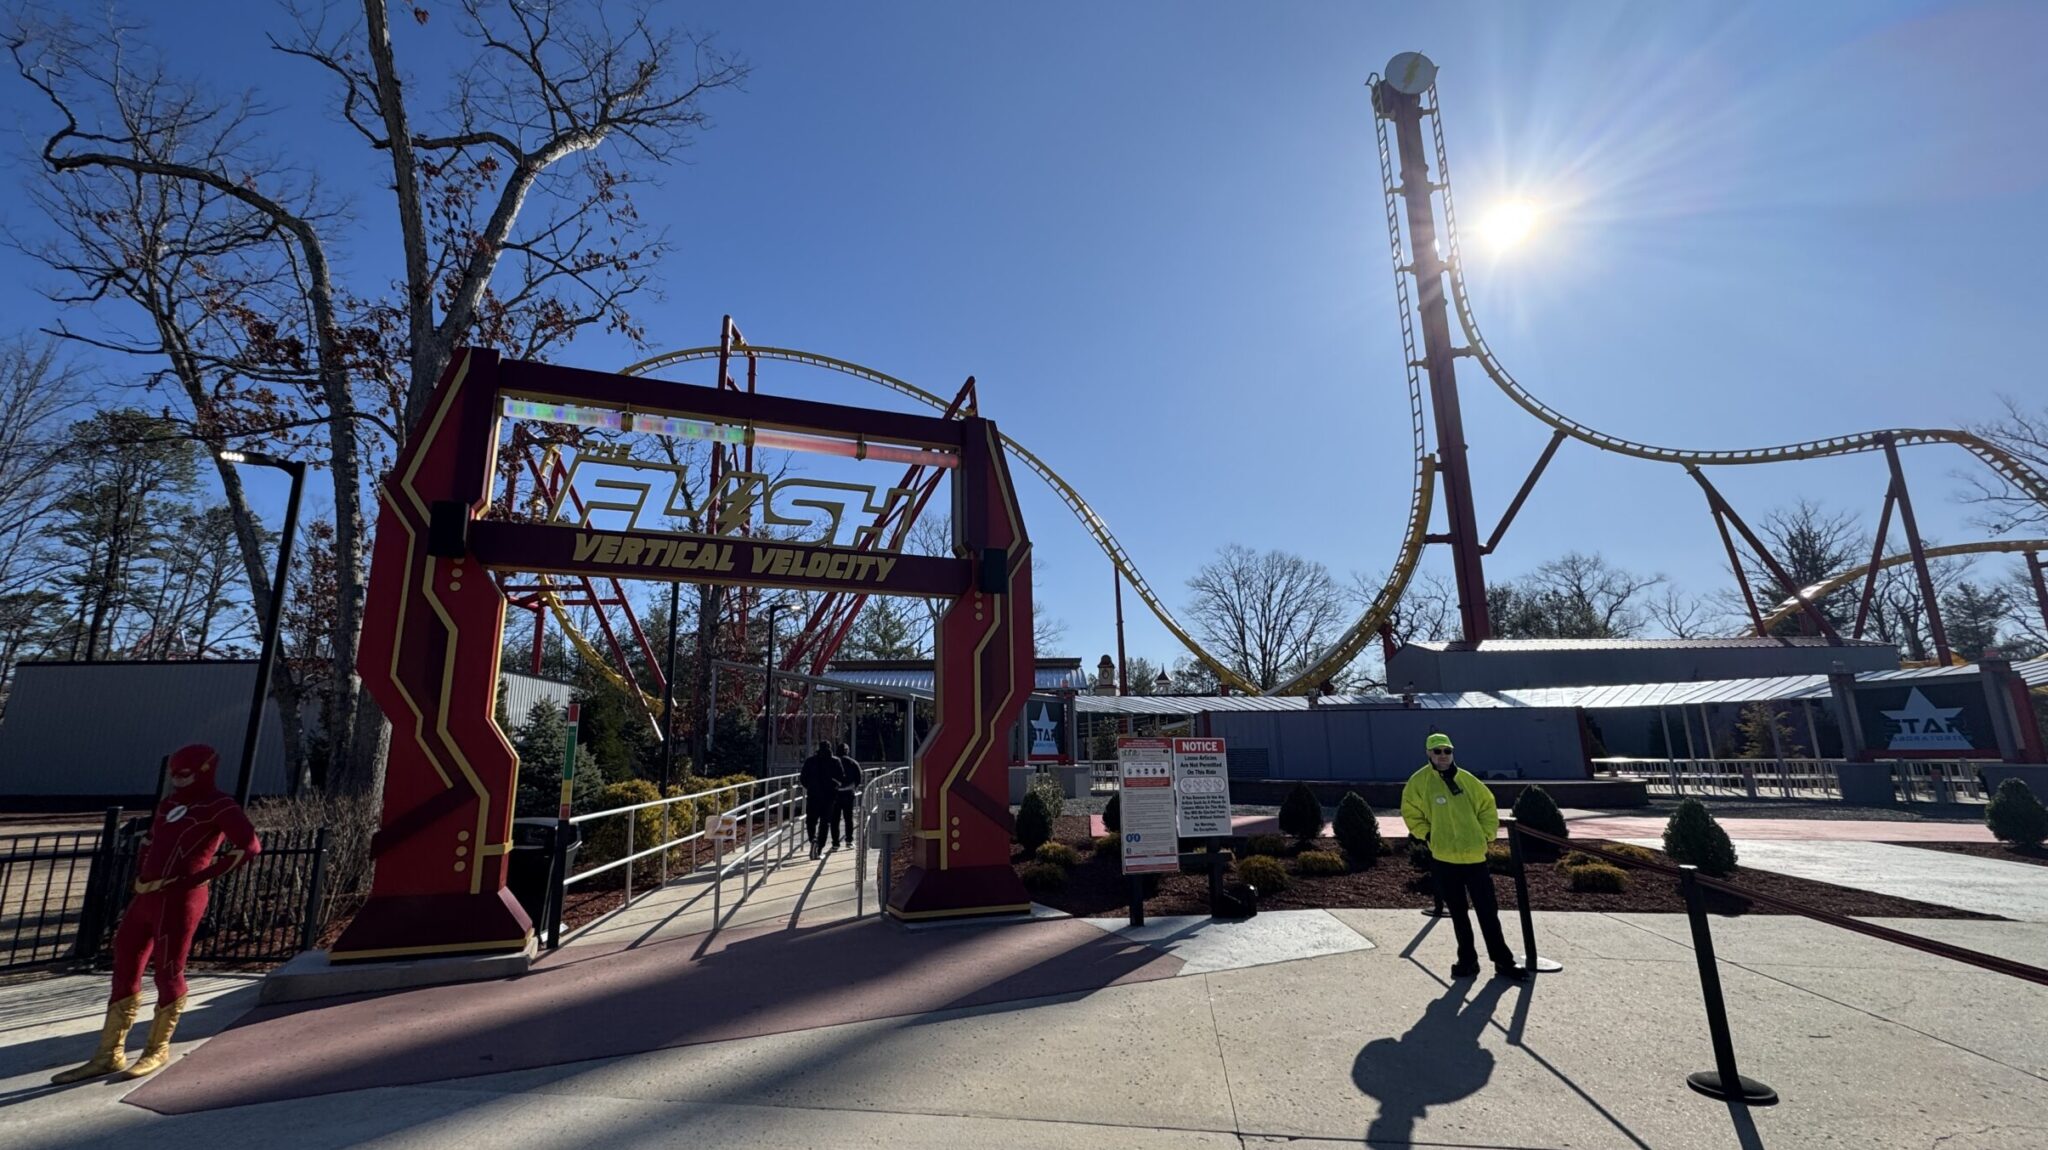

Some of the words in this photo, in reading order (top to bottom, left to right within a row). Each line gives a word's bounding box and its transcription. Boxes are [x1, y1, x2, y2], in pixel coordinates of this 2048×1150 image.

[581, 440, 633, 460] THE
[546, 454, 917, 554] FLASH
[572, 533, 736, 571] VERTICAL
[751, 547, 897, 582] VELOCITY
[1886, 717, 1967, 733] STAR
[1182, 741, 1218, 751] NOTICE
